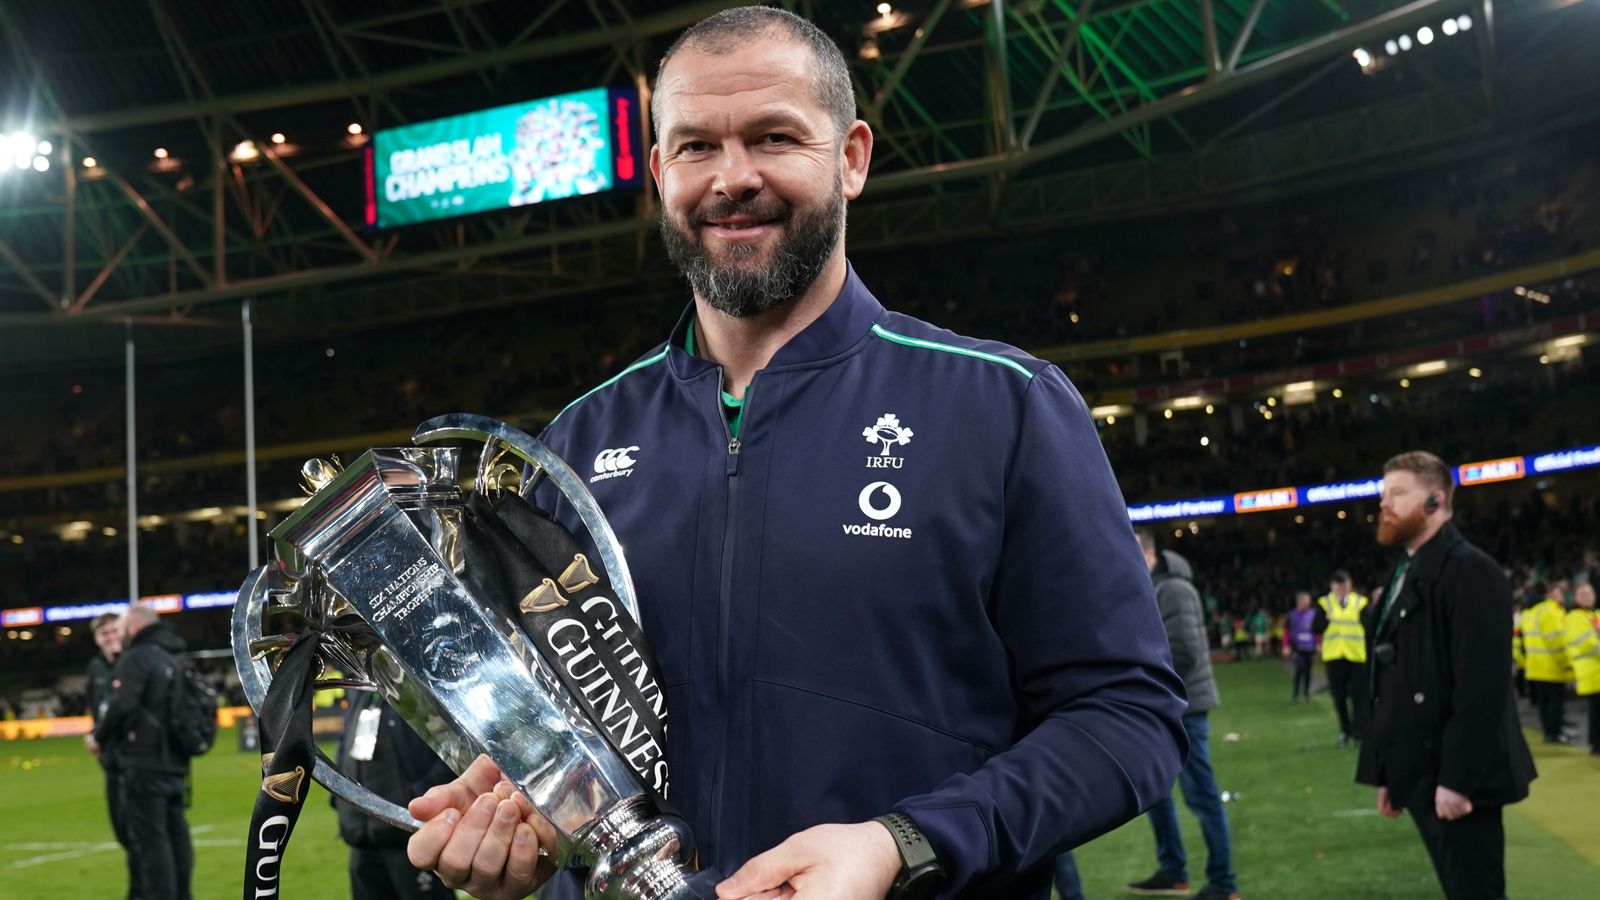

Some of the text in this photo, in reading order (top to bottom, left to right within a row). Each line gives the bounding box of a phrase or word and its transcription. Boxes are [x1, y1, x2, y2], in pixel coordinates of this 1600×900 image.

[451, 133, 503, 164] SLAM
[386, 159, 510, 203] CHAMPIONS
[866, 456, 904, 469] IRFU
[1480, 460, 1518, 480] ALDI
[590, 468, 633, 483] canterbury
[1256, 490, 1292, 508] ALDI
[843, 523, 912, 539] vodafone
[369, 557, 427, 610] SIX NATIONS
[372, 563, 439, 622] CHAMPIONSHIP
[394, 585, 434, 621] TROPHY
